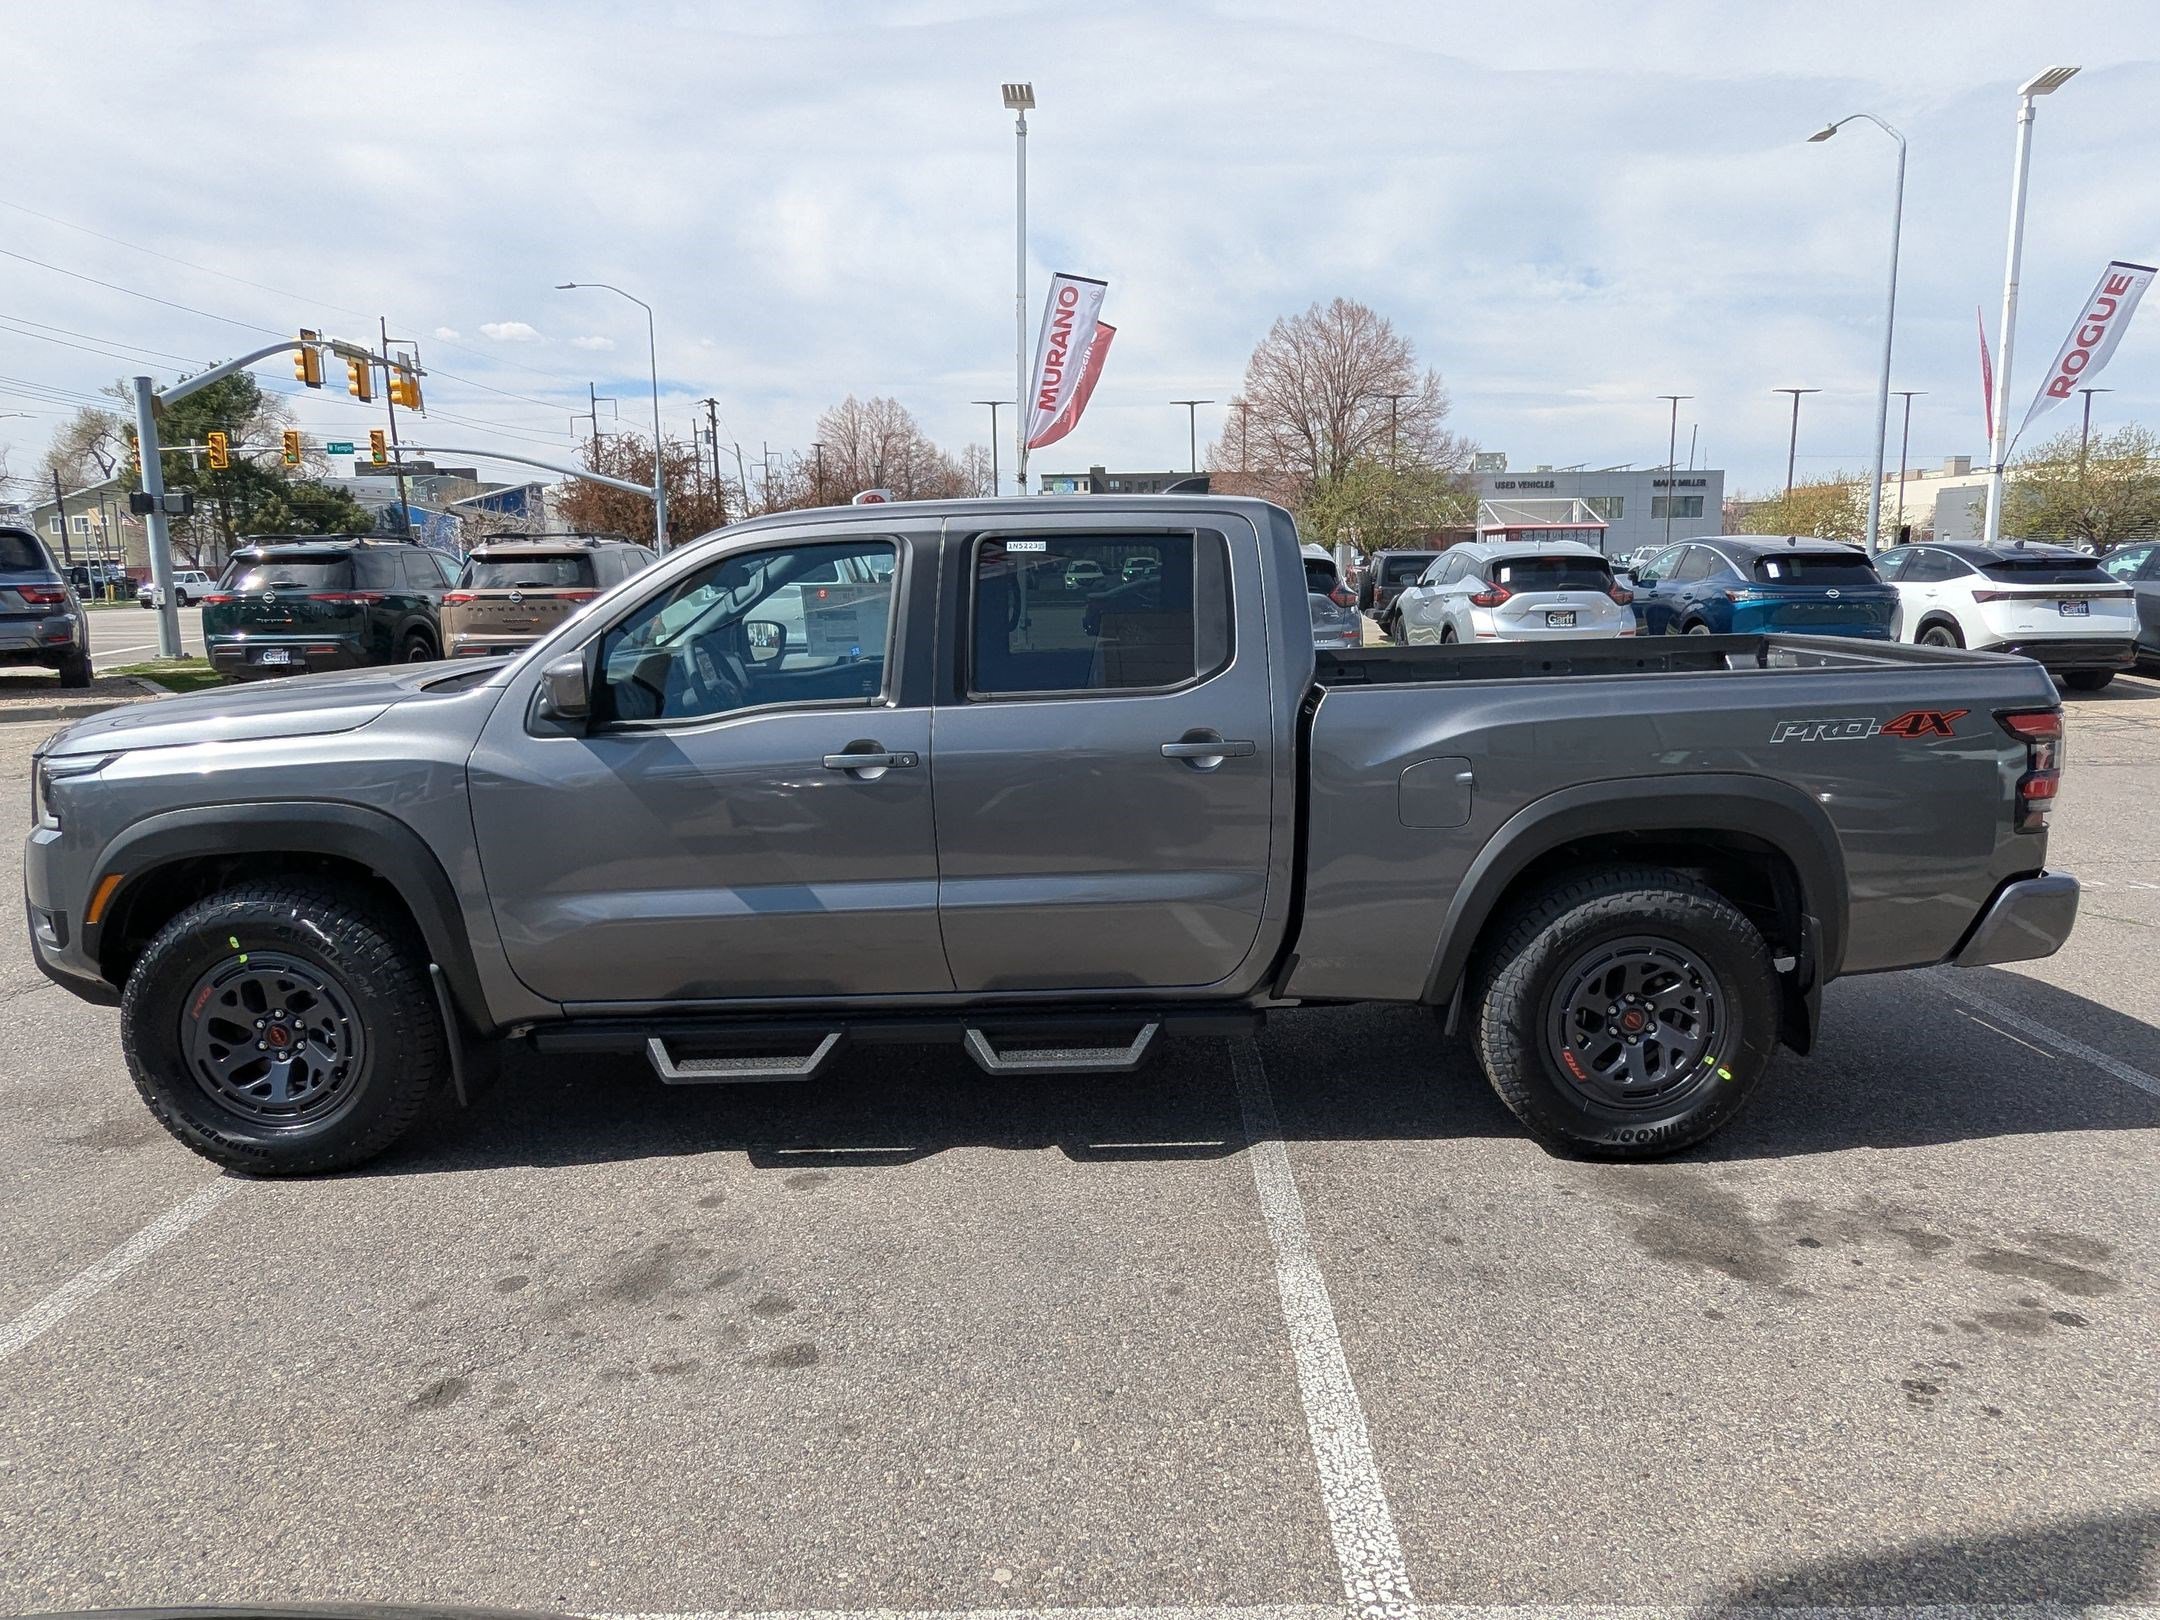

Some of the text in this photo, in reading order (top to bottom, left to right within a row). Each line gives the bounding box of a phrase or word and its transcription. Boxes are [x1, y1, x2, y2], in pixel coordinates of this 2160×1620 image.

[2046, 274, 2134, 399] ROGUE
[1038, 286, 1079, 412] MURANO
[1495, 480, 1555, 489] USED VEHICLES
[1678, 478, 1706, 487] MILLER
[2061, 603, 2087, 613] Garff
[1548, 614, 1574, 624] Garff
[262, 651, 290, 662] Garff
[1769, 709, 1971, 743] PRO-4X
